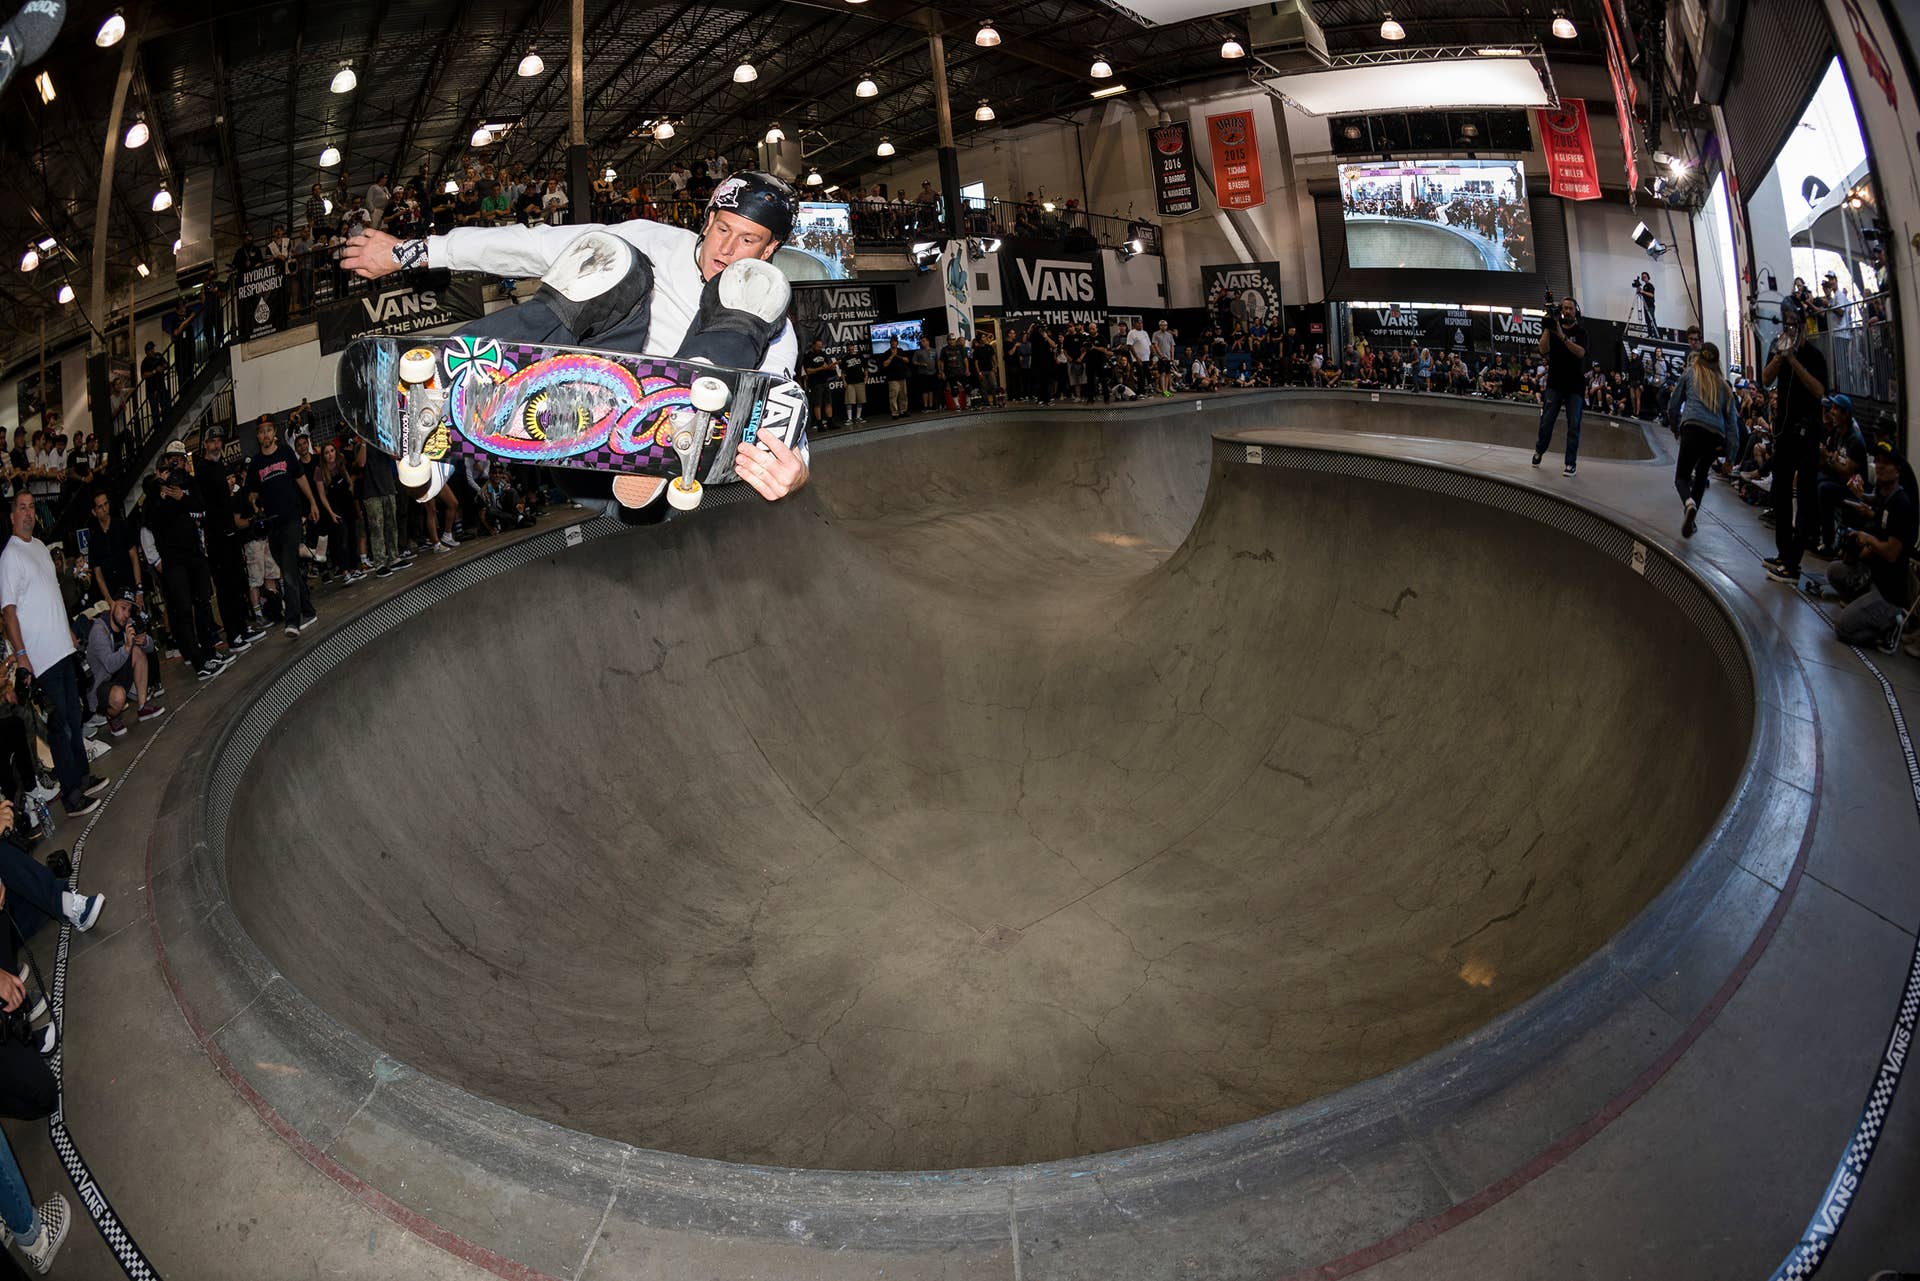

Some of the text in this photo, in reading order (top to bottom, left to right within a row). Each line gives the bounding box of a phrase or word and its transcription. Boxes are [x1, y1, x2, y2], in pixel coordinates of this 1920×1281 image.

[1554, 134, 1579, 148] 2005
[1164, 158, 1181, 170] 2016
[1225, 149, 1246, 161] 2015
[243, 265, 277, 284] HYDRATE
[1016, 258, 1095, 301] VANS
[1217, 270, 1262, 289] VANS
[238, 275, 283, 299] RESPONSIBLY
[362, 288, 438, 323] VANS
[824, 287, 871, 309] VANS
[840, 311, 855, 319] THE
[1045, 311, 1069, 324] THE
[1376, 309, 1418, 327] VANS
[1498, 314, 1543, 335] VANS
[386, 321, 410, 336] THE
[1883, 1023, 1910, 1075] VANS
[78, 1173, 108, 1218] VANS
[1812, 1166, 1858, 1235] VANS
